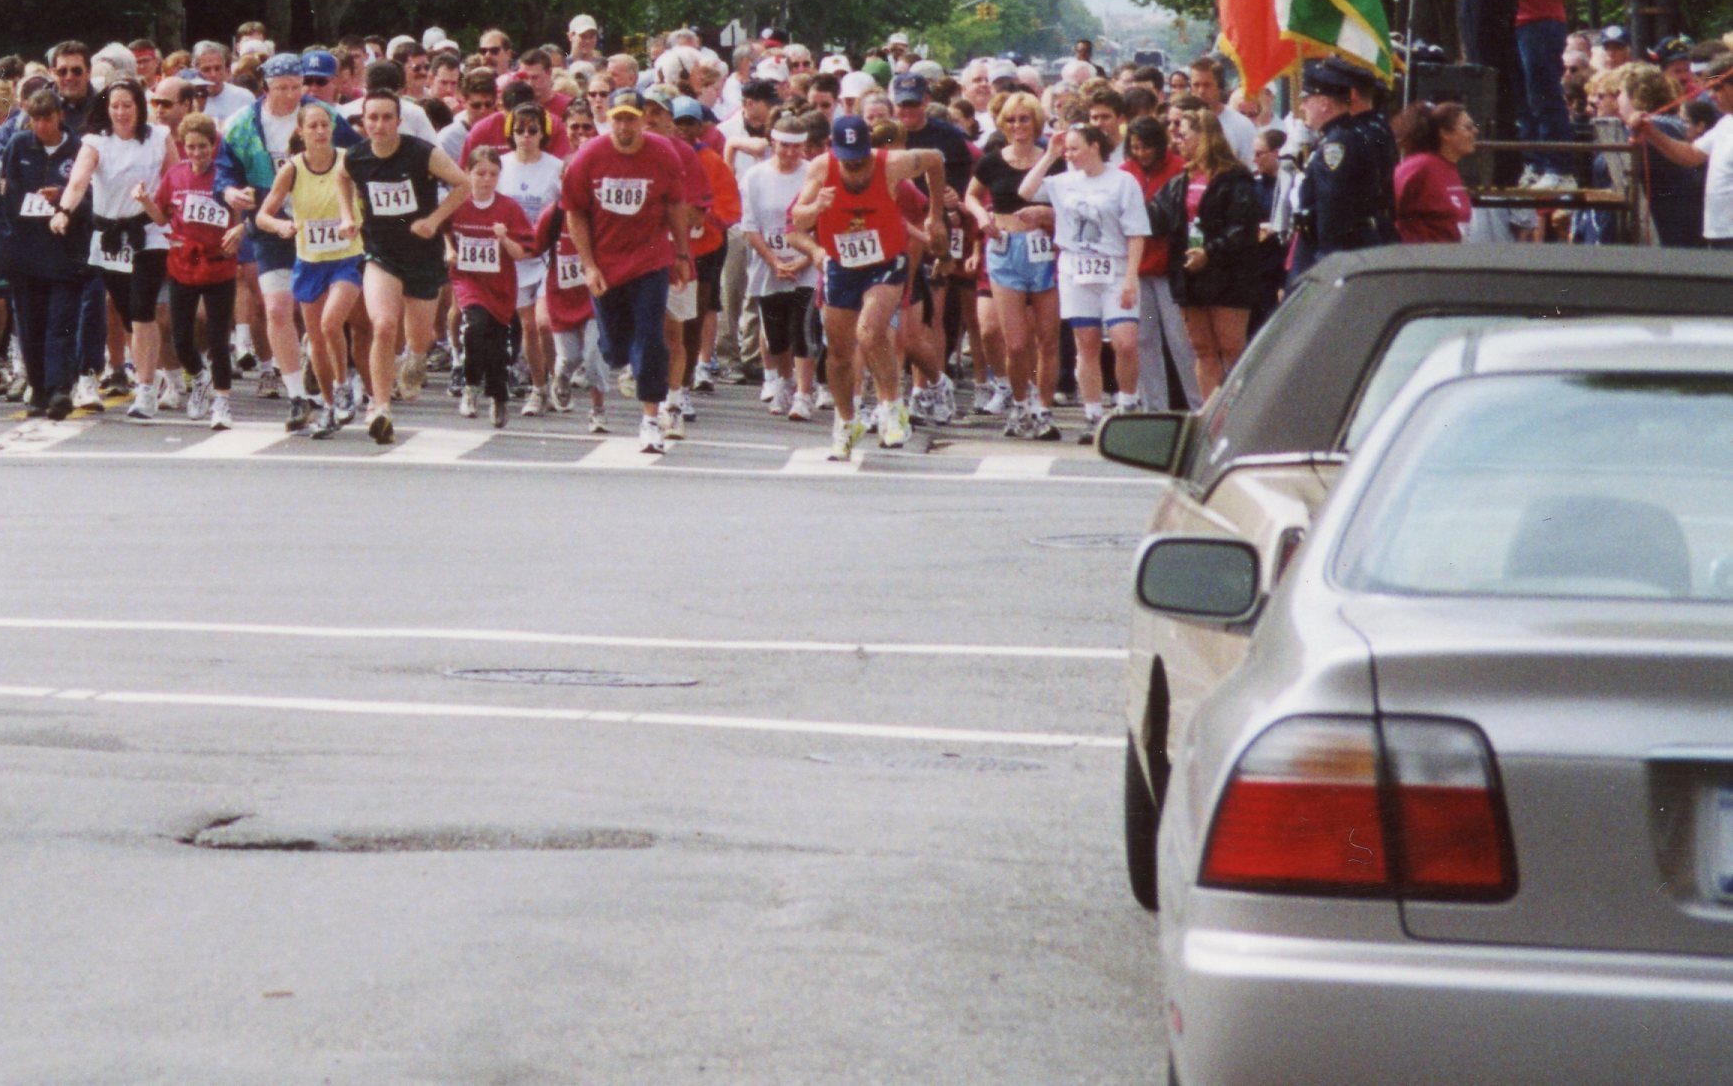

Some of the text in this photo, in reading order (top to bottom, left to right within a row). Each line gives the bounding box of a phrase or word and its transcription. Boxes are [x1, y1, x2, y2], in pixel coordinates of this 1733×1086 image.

[374, 189, 410, 208] 1747
[605, 188, 643, 206] 1808
[188, 204, 226, 226] 1682
[461, 246, 497, 264] 1848
[839, 238, 876, 259] 2047
[1077, 258, 1111, 275] 1329
